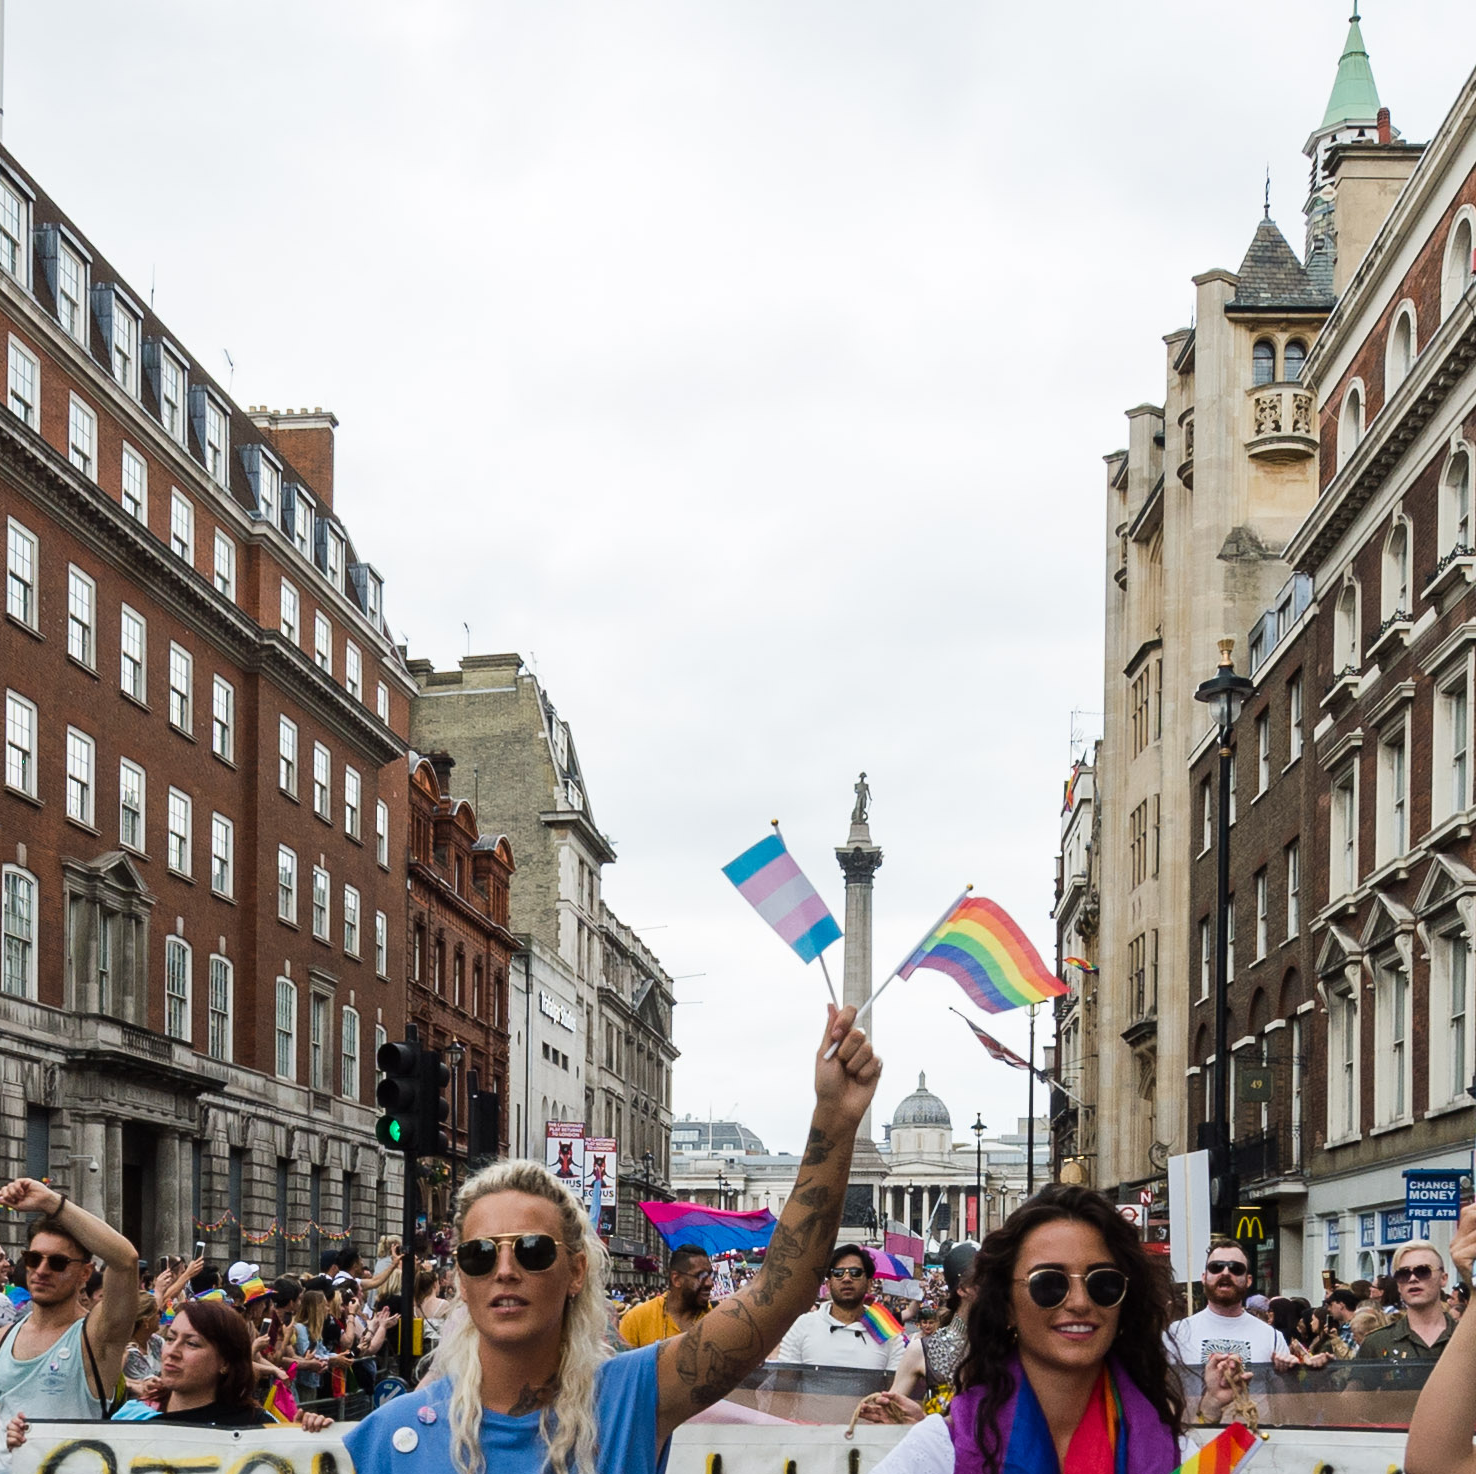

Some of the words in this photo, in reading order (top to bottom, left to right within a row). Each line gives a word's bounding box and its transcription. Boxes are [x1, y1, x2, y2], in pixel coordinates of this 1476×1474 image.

[1250, 1080, 1263, 1089] 49
[1409, 1180, 1456, 1190] CHANGE
[584, 1189, 614, 1198] EQUS
[1140, 1191, 1152, 1204] N
[1408, 1190, 1457, 1200] MONEY
[1408, 1208, 1433, 1217] FREE
[1435, 1209, 1457, 1217] ATM
[1363, 1216, 1374, 1229] FRE
[1387, 1226, 1412, 1241] MONEY
